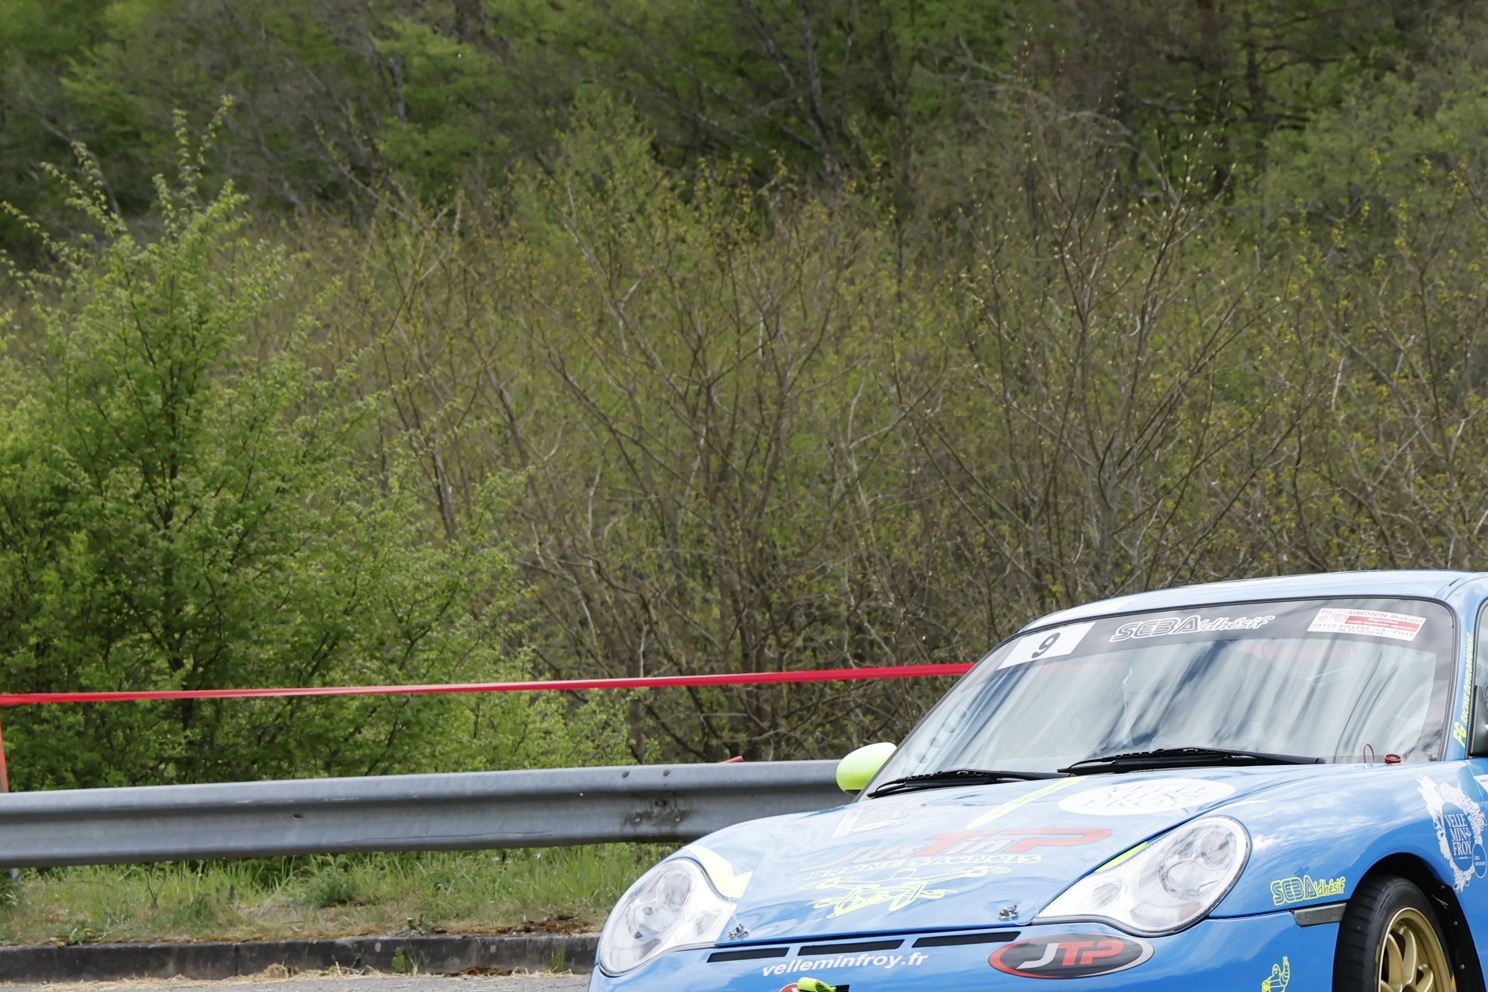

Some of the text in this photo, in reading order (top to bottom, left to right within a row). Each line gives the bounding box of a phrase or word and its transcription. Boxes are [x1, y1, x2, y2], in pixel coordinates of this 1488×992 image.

[1348, 610, 1388, 618] SIMONIN
[1031, 632, 1061, 659] 9
[1453, 721, 1468, 749] FG
[1444, 813, 1468, 829] VELLE
[1453, 840, 1472, 856] FROY
[762, 951, 930, 977] velleminfroy.fr
[1016, 940, 1126, 970] JTP
